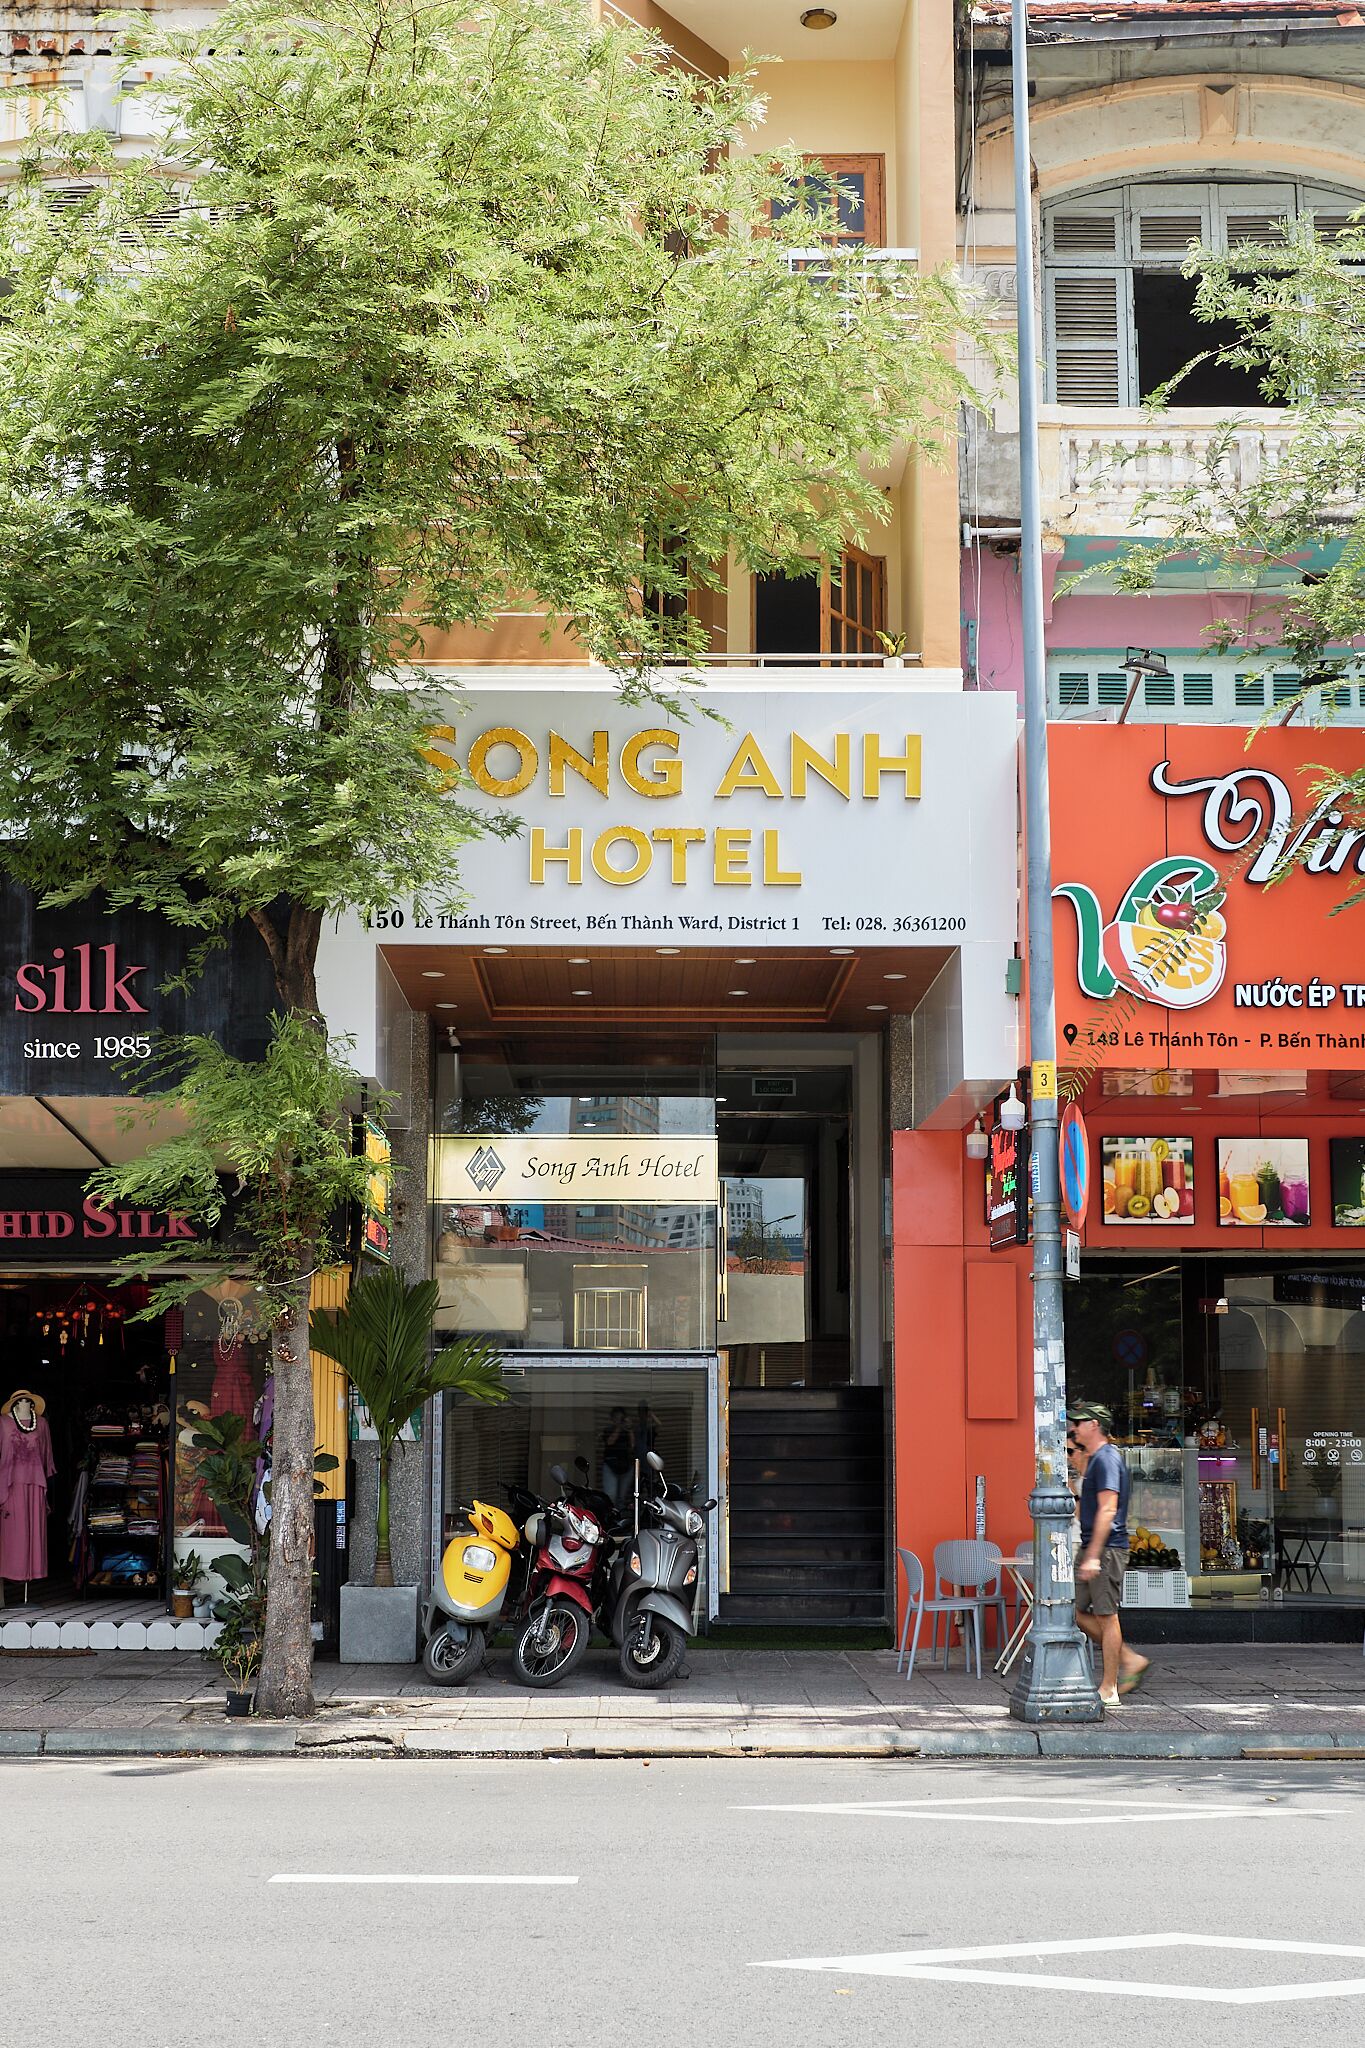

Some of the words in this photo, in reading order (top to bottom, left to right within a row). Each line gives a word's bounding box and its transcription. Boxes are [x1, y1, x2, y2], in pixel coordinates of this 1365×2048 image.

[714, 730, 922, 801] ANH
[529, 825, 802, 886] HOTEL
[437, 913, 490, 929] Thánh
[494, 914, 526, 929] Tôn
[530, 915, 581, 932] Street,
[586, 913, 617, 930] Bến
[621, 914, 674, 930] Thành
[678, 914, 723, 932] Ward,
[727, 915, 786, 930] District
[792, 916, 799, 930] 1
[822, 916, 851, 931] Tel:
[855, 916, 887, 931] 028.
[892, 915, 966, 932] 36361200
[15, 943, 149, 1013] silk
[1235, 977, 1303, 1007] NƯỚC
[1308, 977, 1337, 1007] ÉP
[23, 1038, 81, 1059] since
[93, 1036, 152, 1059] 1985
[1124, 1032, 1144, 1047] Lê
[1149, 1032, 1204, 1047] Thánh
[1206, 1032, 1238, 1047] Tôn
[1260, 1033, 1273, 1048] P.
[1278, 1031, 1311, 1048] Bến
[1041, 1073, 1048, 1087] 3
[521, 1156, 578, 1185] Song
[581, 1154, 631, 1178] Anh
[637, 1154, 705, 1178] Hotel
[1305, 1438, 1326, 1447] 8:00
[1335, 1438, 1362, 1447] 23:00
